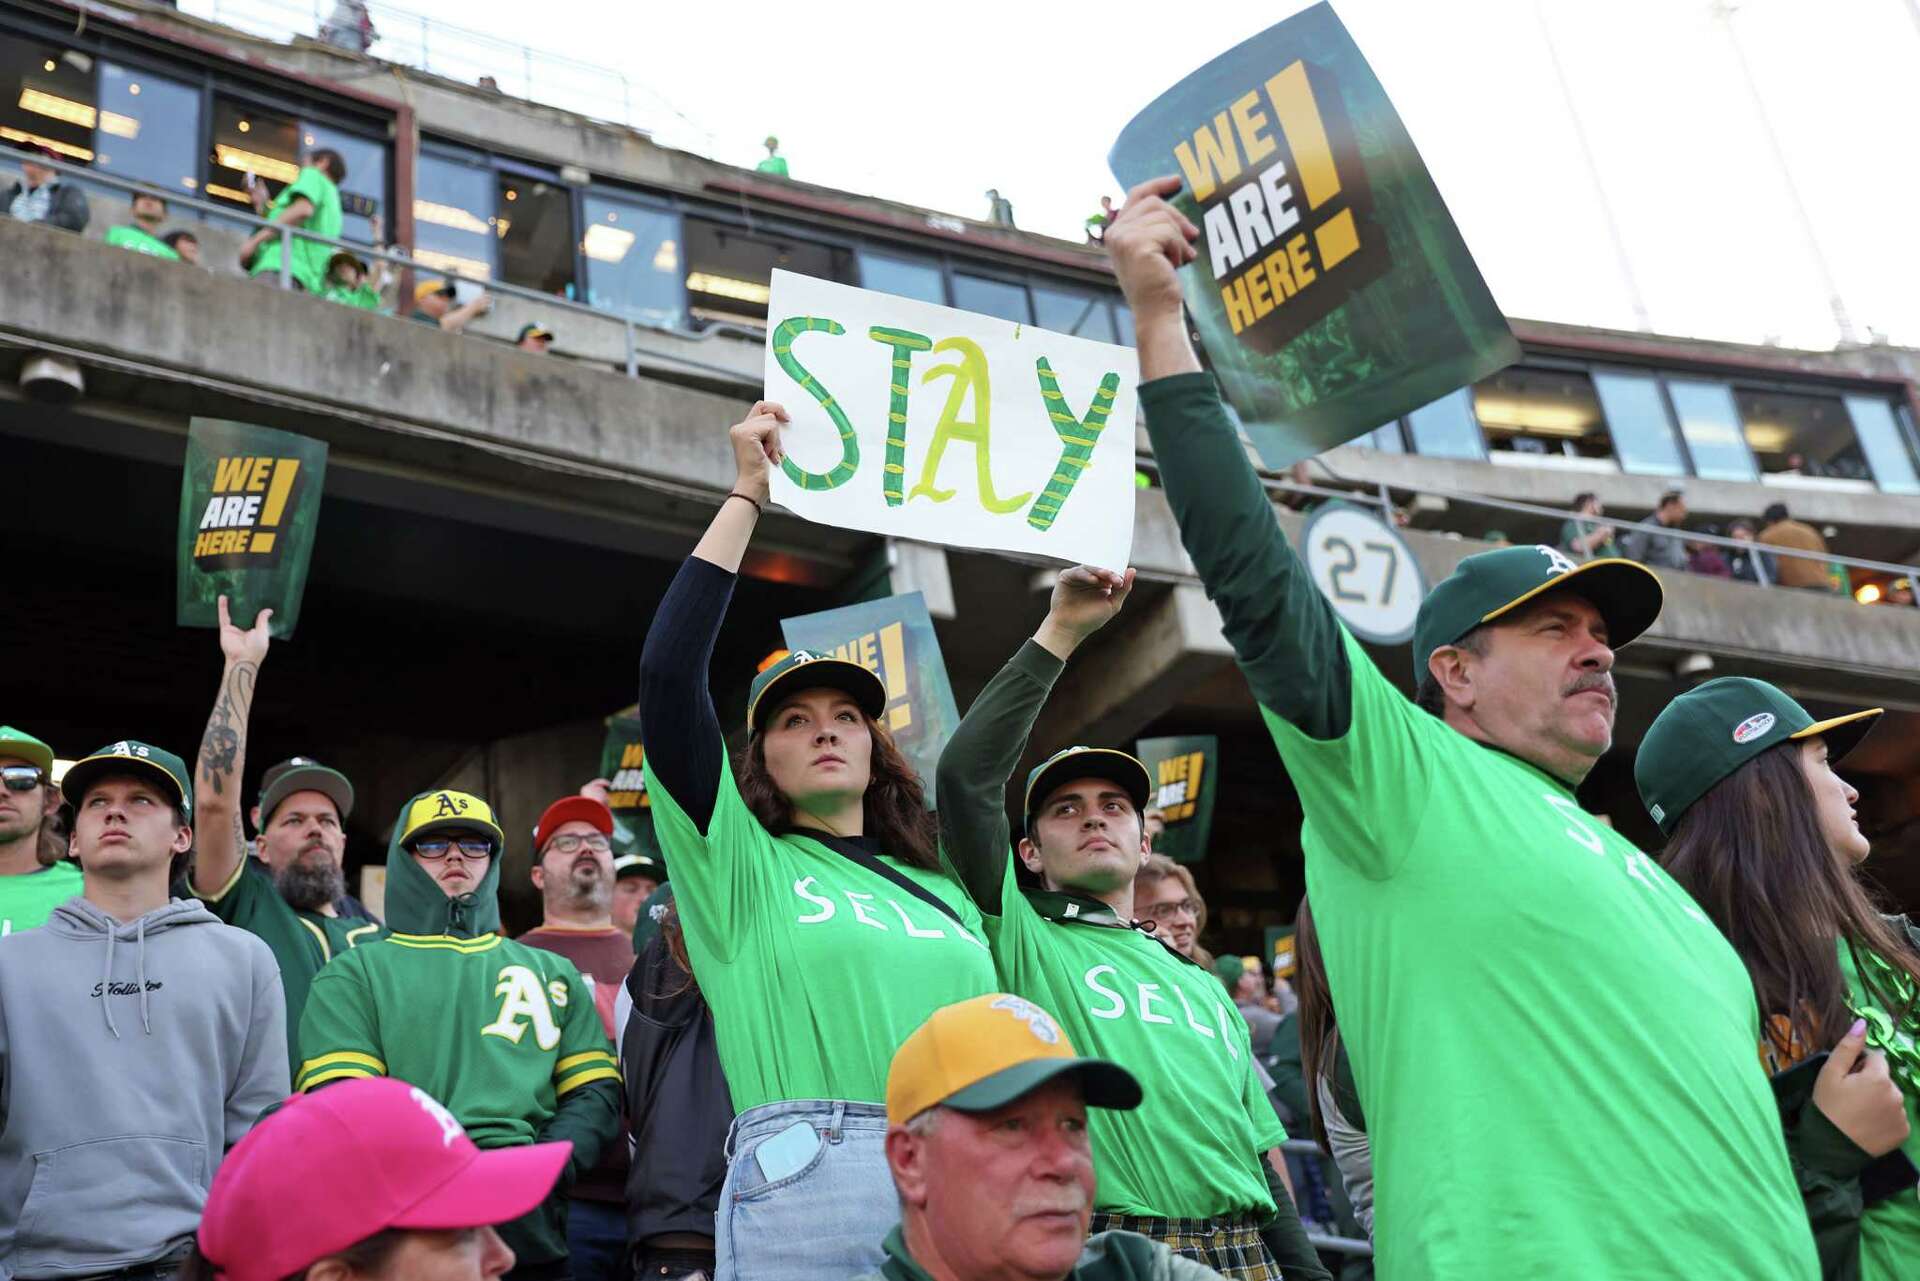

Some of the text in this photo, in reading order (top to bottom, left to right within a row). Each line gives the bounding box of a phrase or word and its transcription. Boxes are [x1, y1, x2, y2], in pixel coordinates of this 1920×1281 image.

[1174, 90, 1277, 203] WE
[1203, 160, 1300, 280] ARE
[772, 316, 1121, 532] STAY
[212, 457, 273, 493] WE
[199, 495, 262, 530] ARE
[1323, 536, 1397, 605] 27
[432, 792, 469, 818] A's
